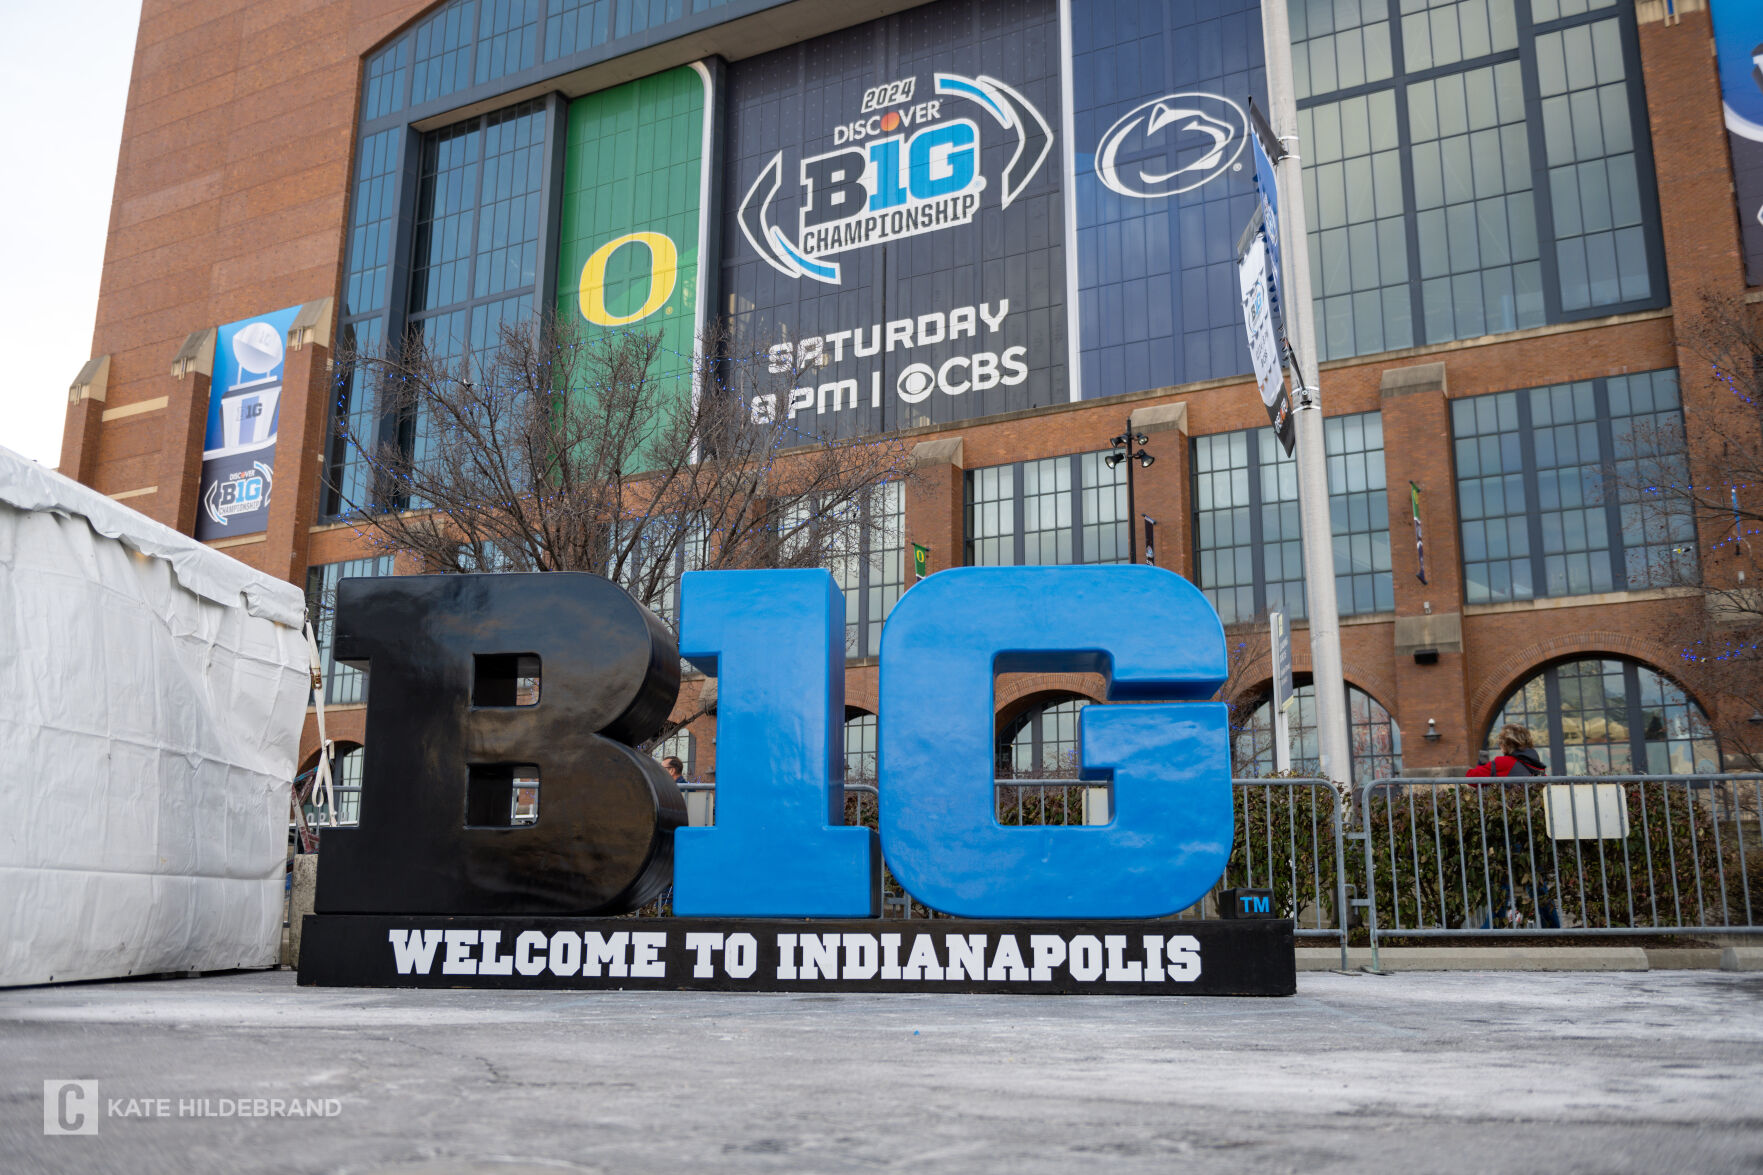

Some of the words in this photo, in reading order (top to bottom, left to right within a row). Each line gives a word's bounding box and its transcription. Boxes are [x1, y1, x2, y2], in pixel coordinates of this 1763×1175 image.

[864, 81, 913, 112] 2024
[834, 102, 941, 146] DISCOVER
[803, 193, 976, 256] CHAMPIONSHIP
[768, 299, 1009, 374] SATURDAY
[938, 346, 1028, 396] CBS
[1239, 895, 1271, 913] TM
[389, 930, 666, 977] WELCOME
[686, 933, 757, 978] TO
[777, 934, 1201, 981] INDIANAPOLIS
